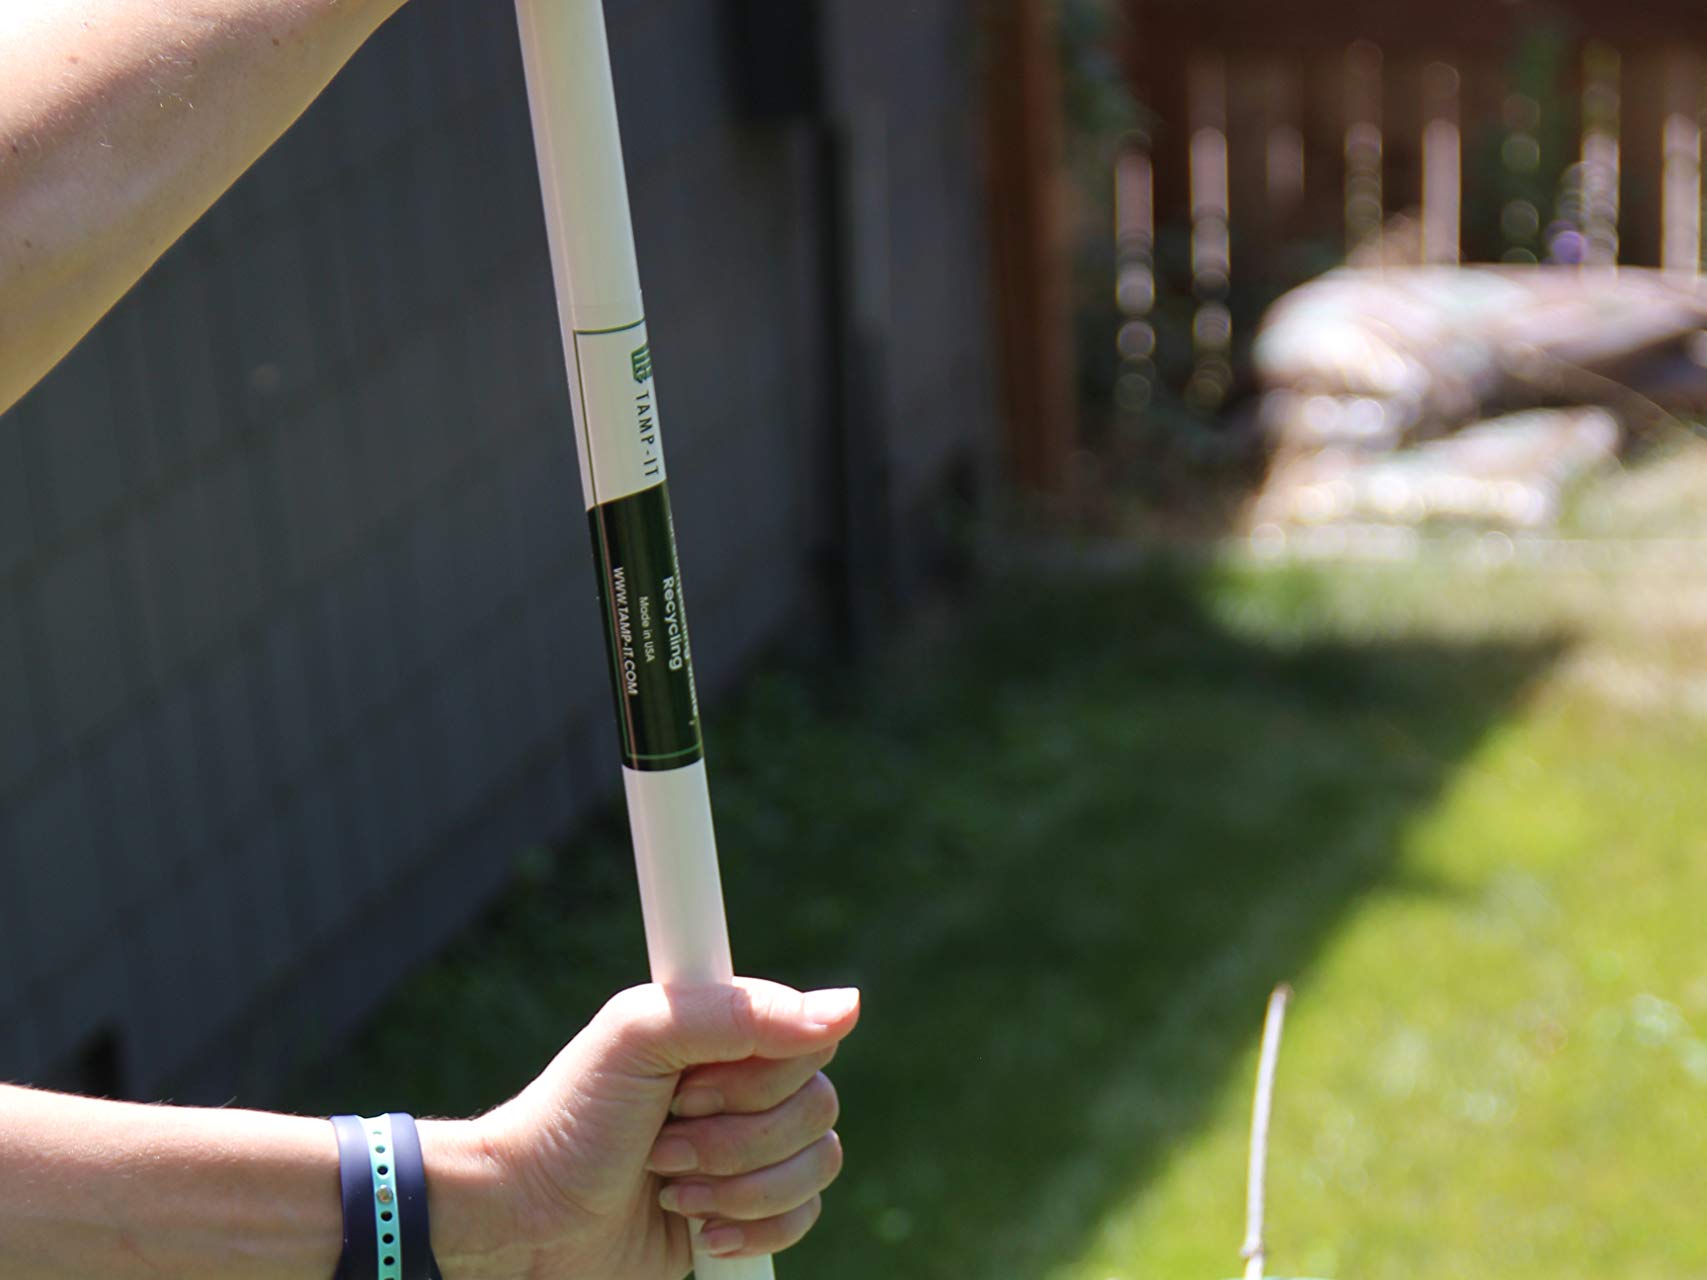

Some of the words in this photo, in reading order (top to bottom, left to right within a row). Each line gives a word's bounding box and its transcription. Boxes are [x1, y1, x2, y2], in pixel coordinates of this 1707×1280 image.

[636, 390, 659, 476] TAMP-IT
[613, 566, 638, 696] WWW.TAMP-IT.COM
[639, 596, 650, 628] Made
[643, 641, 656, 663] USA
[663, 575, 683, 671] Recycling
